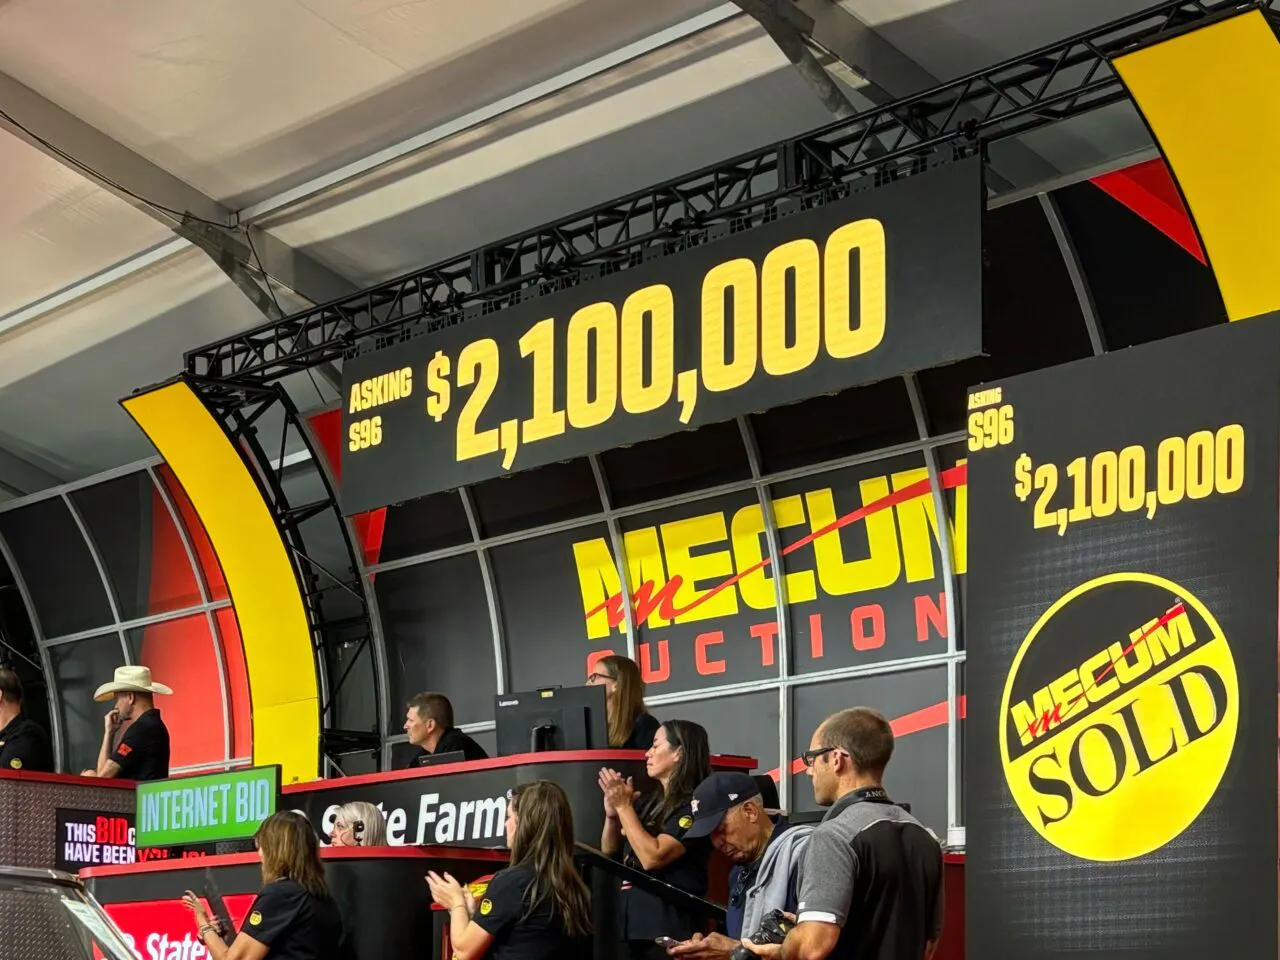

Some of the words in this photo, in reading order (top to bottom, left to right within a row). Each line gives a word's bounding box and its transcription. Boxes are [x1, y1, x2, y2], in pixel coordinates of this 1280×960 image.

[349, 366, 413, 413] ASKING
[426, 218, 886, 470] $2,100,000
[349, 416, 383, 452] S96
[968, 405, 1014, 452] S96
[1015, 424, 1245, 536] $2,100,000
[1010, 601, 1197, 747] MECUM
[1028, 664, 1229, 830] SOLD
[64, 822, 96, 843] THIS
[96, 816, 128, 845] BID
[141, 781, 231, 834] INTERNET
[234, 778, 270, 823] BID
[416, 793, 508, 846] Farm
[64, 843, 100, 863] HAVE
[102, 843, 136, 865] BEEN
